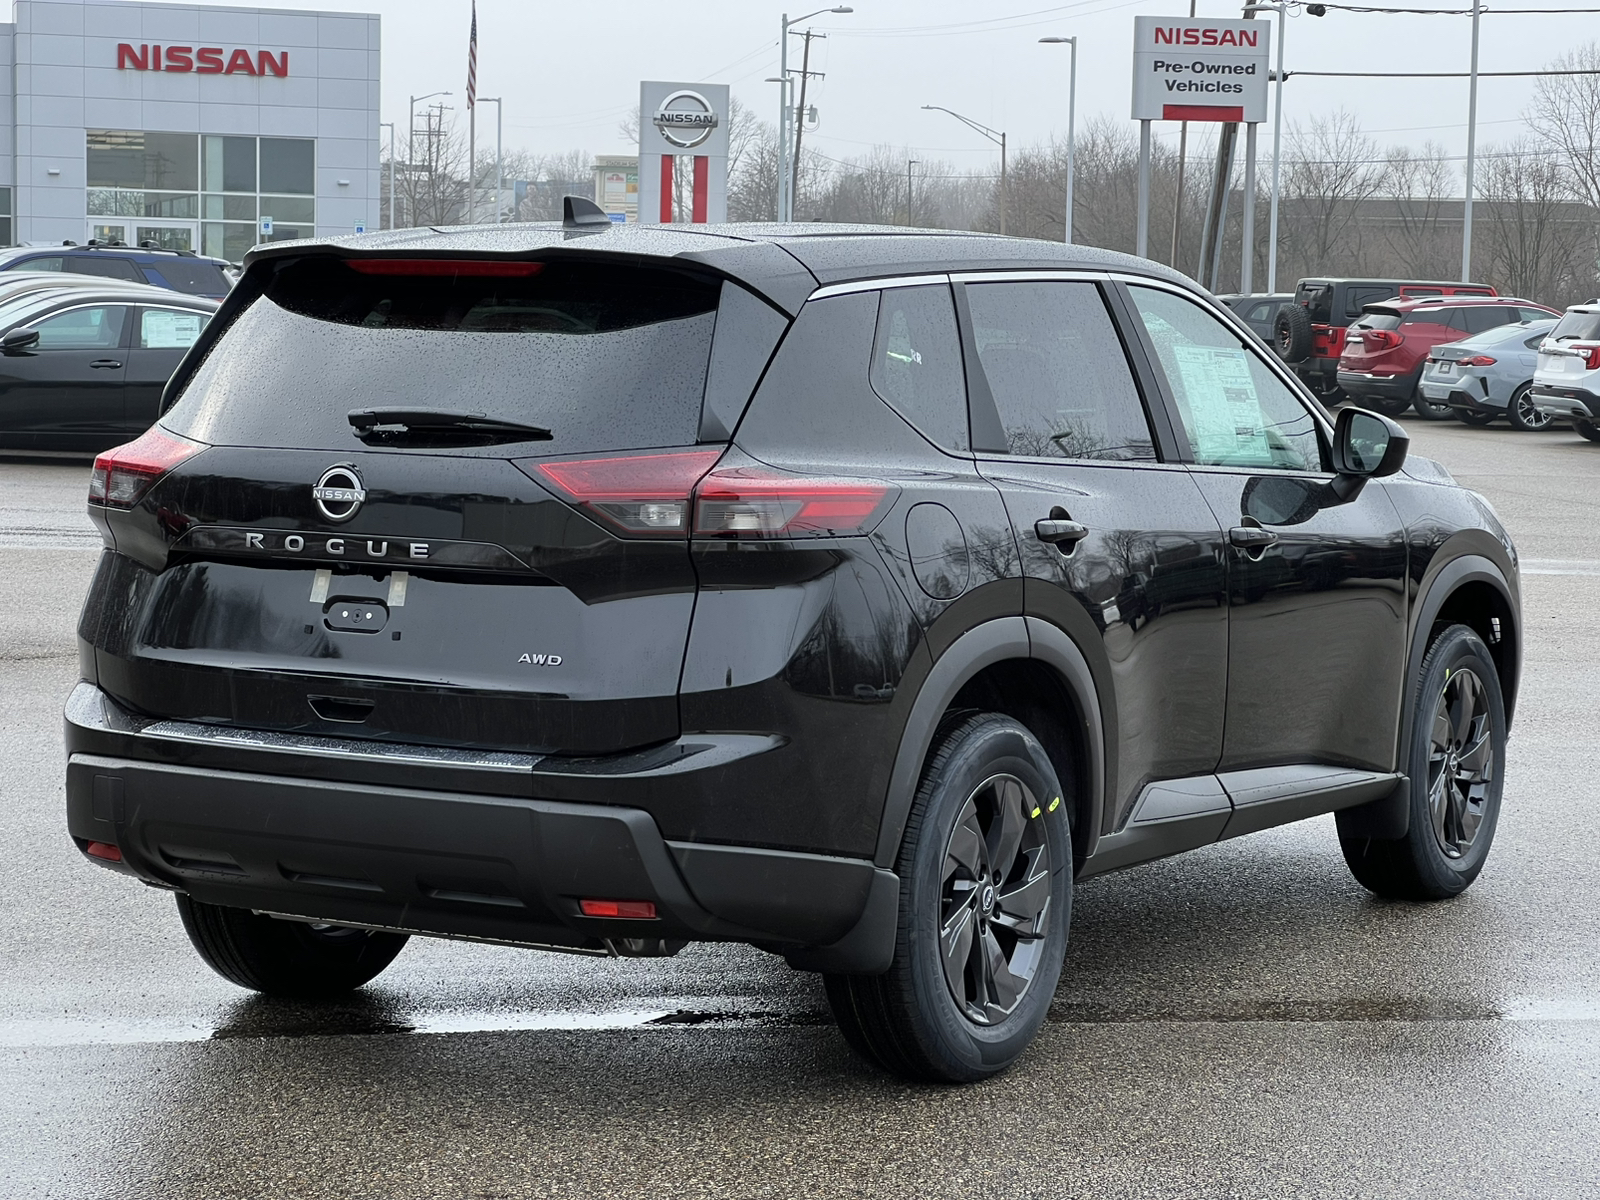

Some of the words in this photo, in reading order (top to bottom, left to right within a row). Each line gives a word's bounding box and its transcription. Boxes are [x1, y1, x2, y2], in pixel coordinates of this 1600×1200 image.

[1154, 27, 1257, 47] NISSAN
[117, 43, 289, 77] NISSAN
[1153, 60, 1256, 75] Pre-Owned
[1165, 79, 1243, 93] Vehicles
[660, 112, 713, 125] NISSAN
[313, 489, 364, 501] NISSAN
[245, 532, 430, 559] ROGUE
[517, 652, 563, 667] AWD
